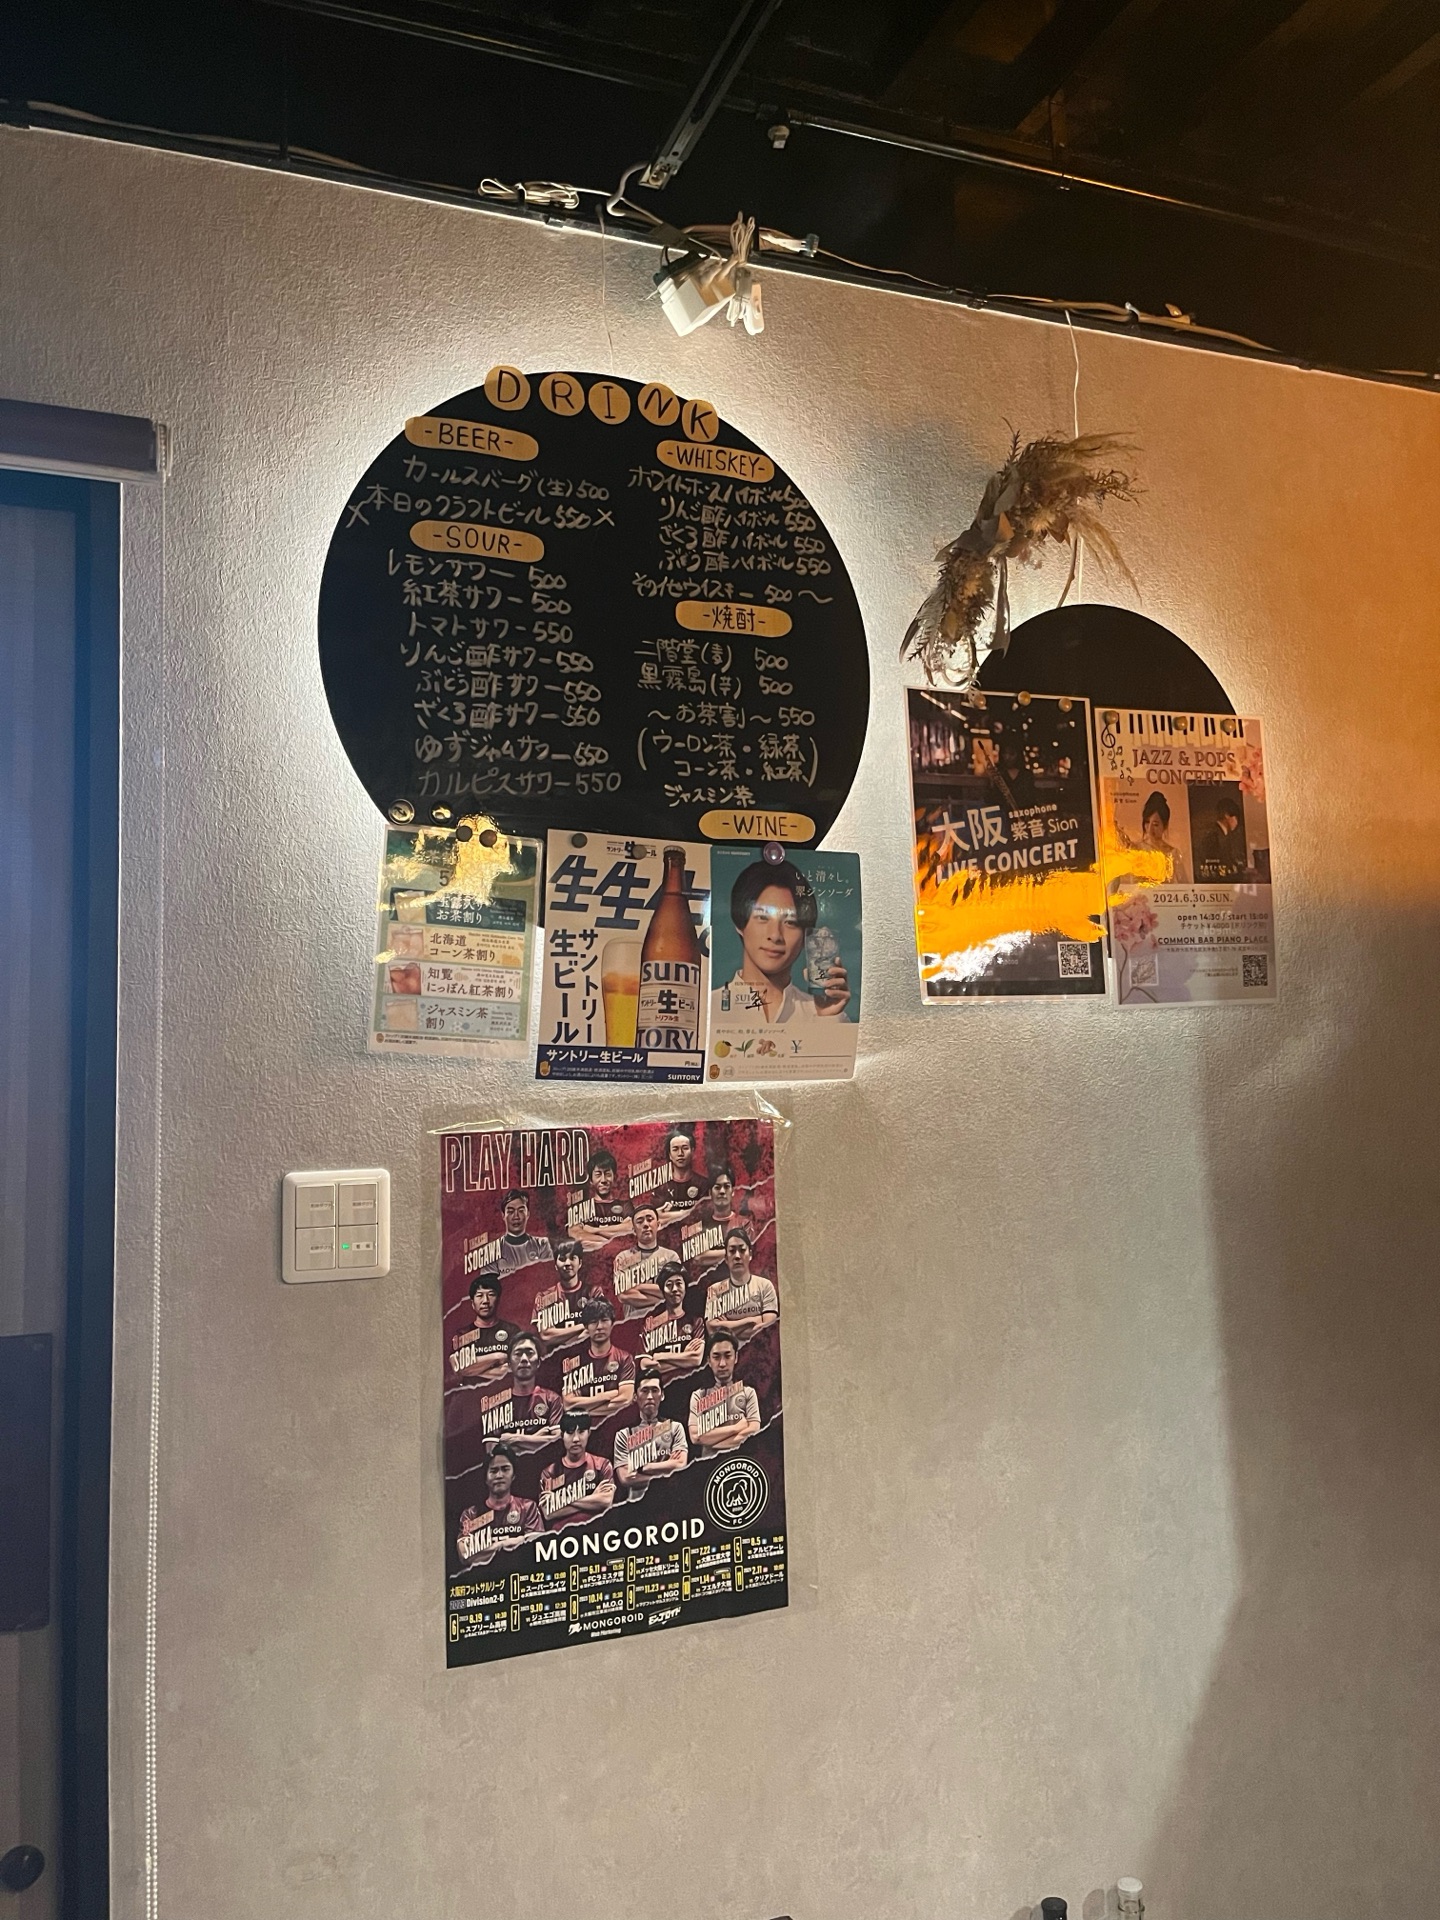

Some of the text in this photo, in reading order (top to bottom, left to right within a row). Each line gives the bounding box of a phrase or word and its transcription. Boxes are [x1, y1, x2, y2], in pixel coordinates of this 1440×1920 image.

[498, 369, 713, 439] DRINK
[577, 480, 610, 501] 500
[784, 511, 817, 533] 550
[793, 535, 826, 556] 550
[528, 565, 568, 590] 500
[795, 556, 832, 577] 550
[531, 591, 572, 615] 500
[531, 620, 574, 644] 550
[556, 650, 595, 674] 550
[753, 647, 789, 671] 500
[562, 680, 602, 704] 550
[758, 674, 794, 696] 500
[560, 704, 601, 728] 550
[777, 706, 816, 727] 550
[572, 741, 610, 768] 550
[1132, 749, 1236, 768] JAZZ & POPS
[575, 771, 623, 796] 550
[1145, 768, 1227, 787] CONCERT
[1008, 804, 1058, 819] saxophone
[931, 805, 1009, 855] 大阪
[1010, 817, 1079, 842] 紫音 Sion
[983, 838, 1079, 876] CONCERT
[435, 909, 483, 925] お茶割り
[1177, 914, 1198, 922] open
[1200, 913, 1220, 921] 14:30
[1227, 913, 1247, 921] start
[429, 932, 467, 947] 北海道
[1157, 935, 1270, 945] COMMON BAR PIANO PLACE
[429, 947, 496, 963] コーン茶割り
[426, 981, 514, 999] にっぽん紅茶割り
[425, 1016, 446, 1030] 割り
[426, 1003, 489, 1020] ジャスミン茶
[546, 1050, 644, 1064] サントリー生ビール
[445, 1129, 591, 1193] PLAY HARD
[629, 1161, 674, 1199] CHIKAZAWA
[567, 1197, 597, 1228] OGAWA
[682, 1224, 725, 1263] NISHIMURA
[464, 1237, 503, 1276] ISOGAWA
[536, 1299, 571, 1333] FUKUDA
[453, 1343, 478, 1373] SOBA
[562, 1362, 595, 1396] TASAKA
[481, 1401, 514, 1436] YANAGI
[697, 1402, 729, 1438] HIGUCHI
[713, 1462, 760, 1485] MONGOROID
[544, 1475, 588, 1517] TAKASAKI
[463, 1525, 493, 1560] SAKKA
[535, 1517, 705, 1564] MONGOROID
[663, 1589, 680, 1599] NGO
[583, 1612, 645, 1631] MONGOROID
